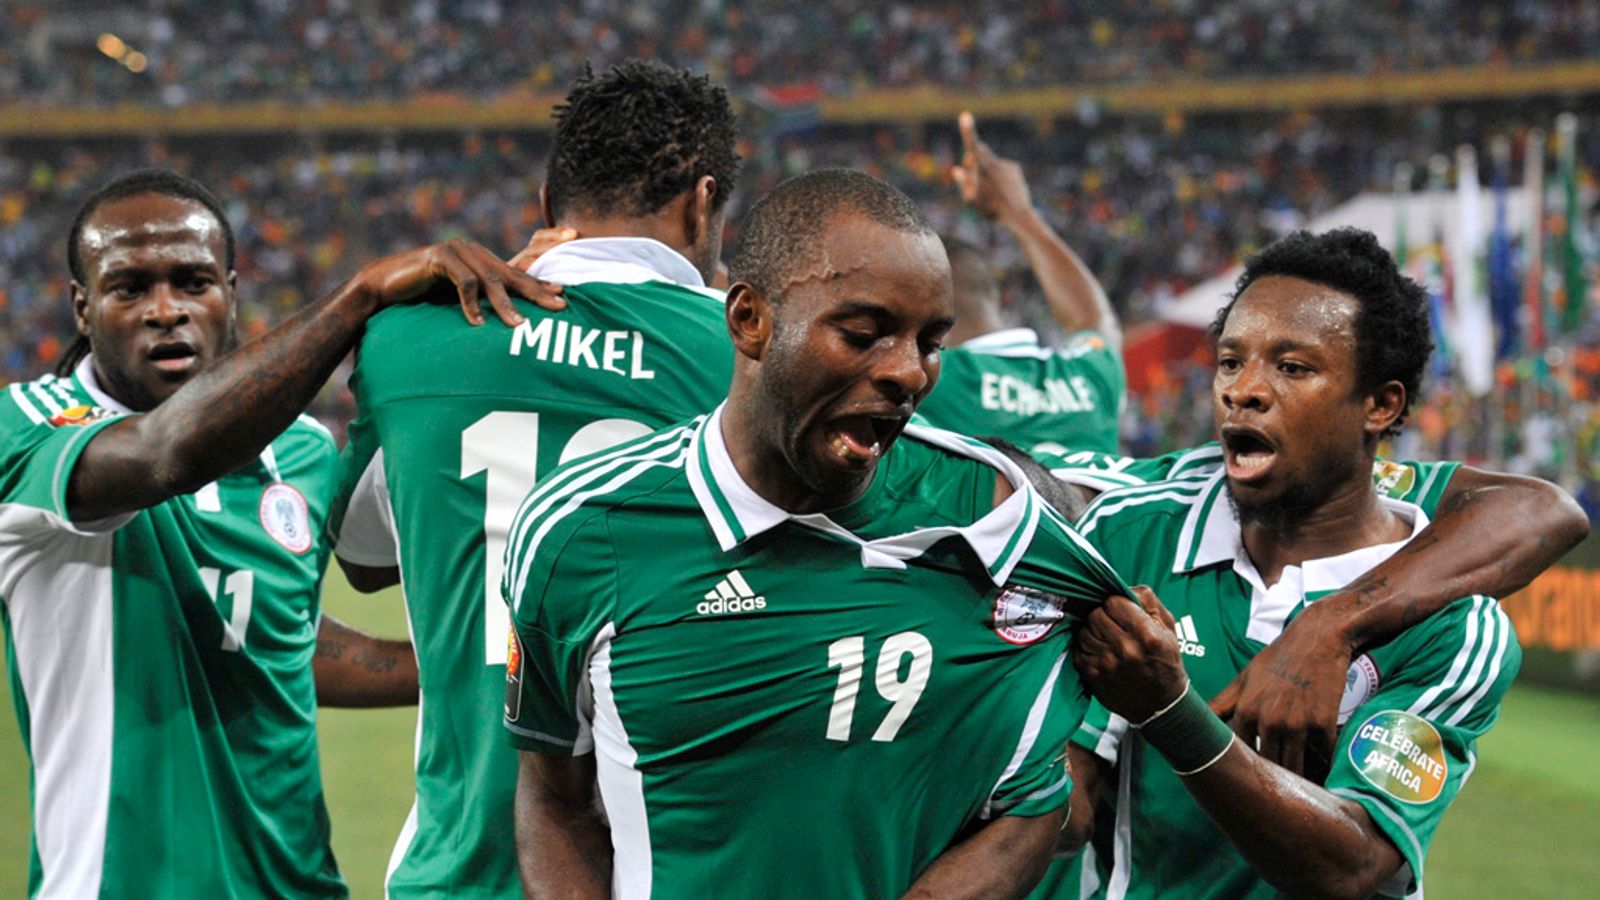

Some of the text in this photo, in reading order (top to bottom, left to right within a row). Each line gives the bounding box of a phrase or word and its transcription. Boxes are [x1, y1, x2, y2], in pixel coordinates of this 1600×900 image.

[509, 317, 655, 379] MIKEL
[696, 595, 767, 615] adidas
[825, 631, 933, 742] 19
[1360, 724, 1444, 781] CELEBRATE
[1363, 749, 1422, 793] AFRICA
